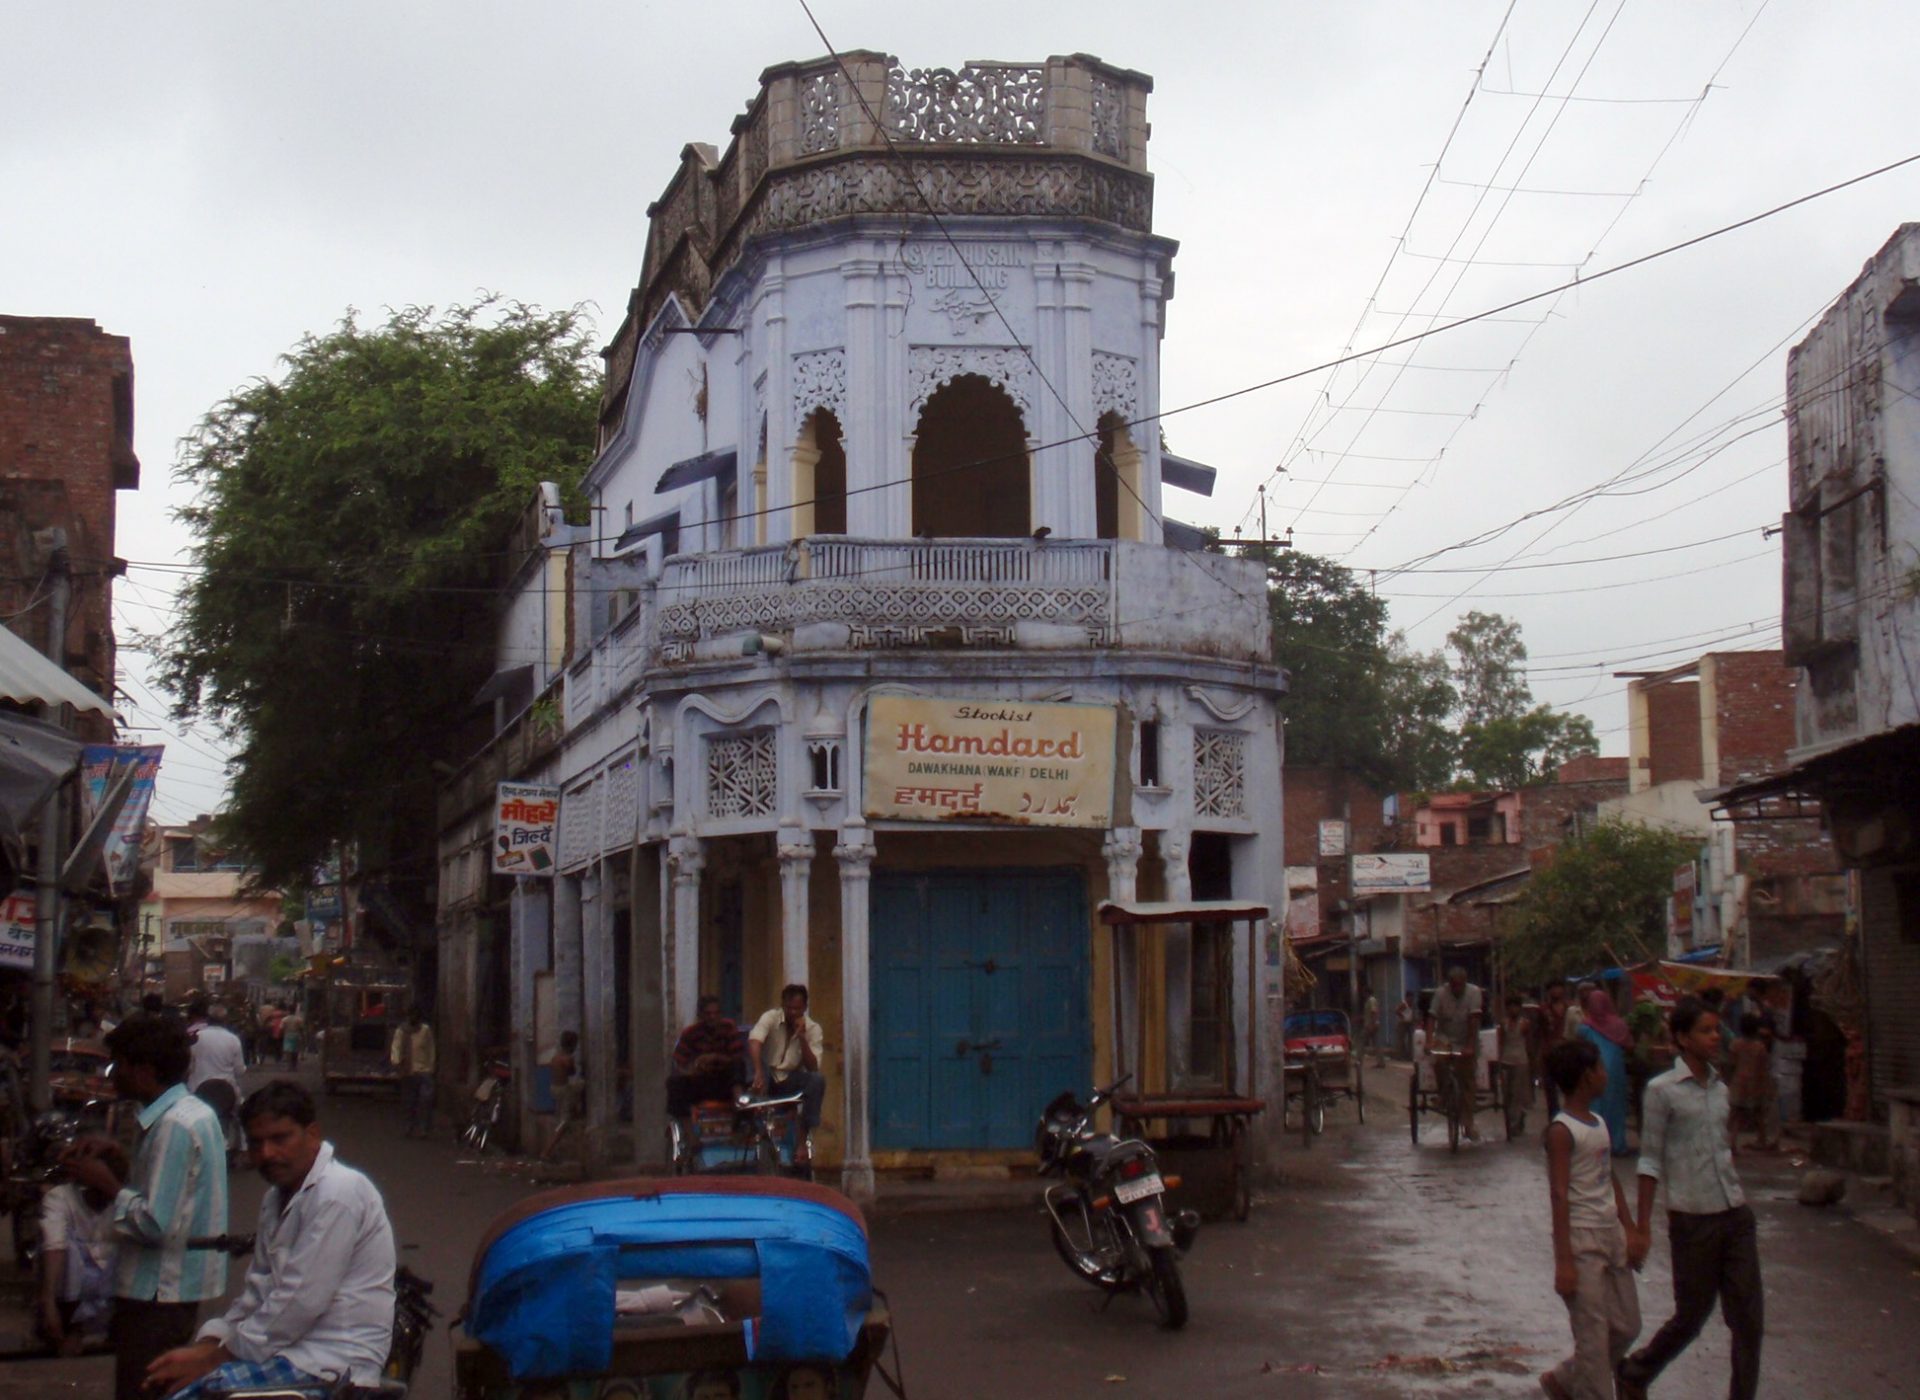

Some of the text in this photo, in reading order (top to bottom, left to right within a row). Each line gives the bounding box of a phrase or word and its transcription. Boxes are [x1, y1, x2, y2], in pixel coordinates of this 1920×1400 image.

[907, 243, 1026, 269] SYED HUSAIN
[926, 267, 1008, 290] BUILDING
[953, 706, 1034, 722] Stockist
[897, 723, 1084, 760] Hamdard
[908, 761, 982, 776] DAWAKHANA
[1029, 766, 1069, 781] DELHI
[894, 783, 984, 811] हमदर्द
